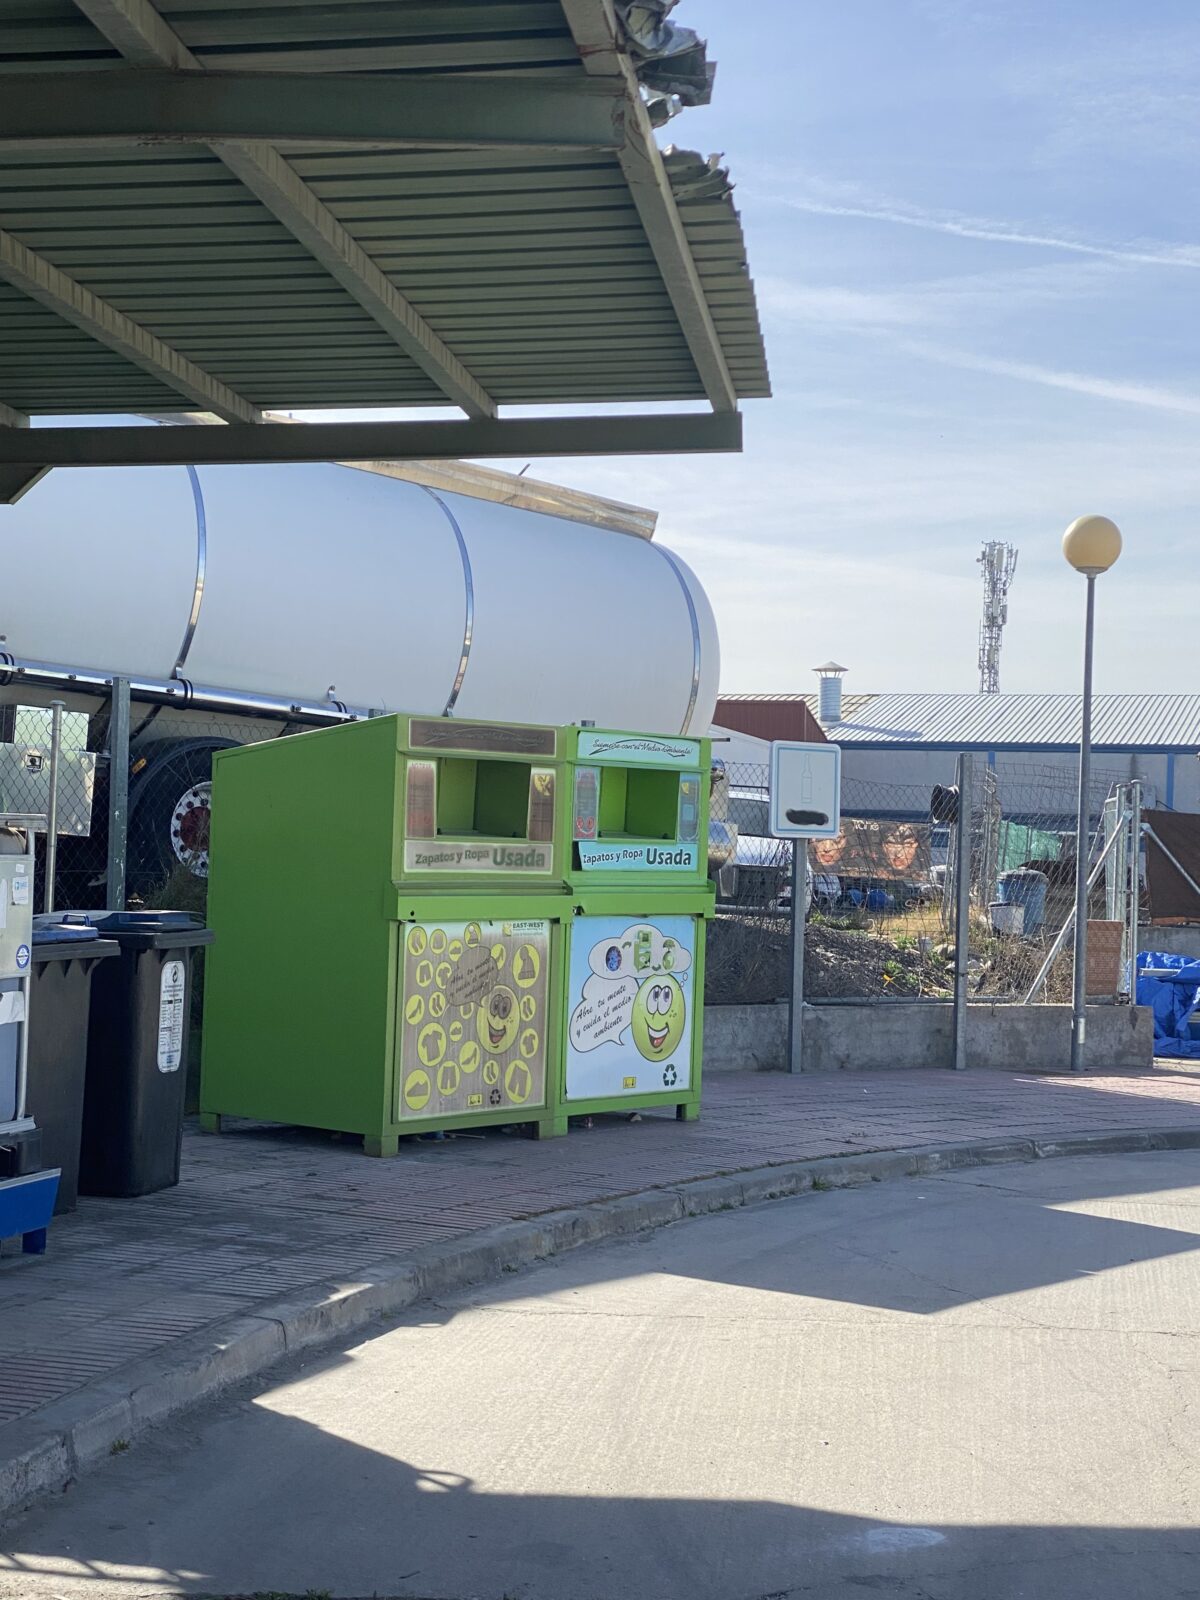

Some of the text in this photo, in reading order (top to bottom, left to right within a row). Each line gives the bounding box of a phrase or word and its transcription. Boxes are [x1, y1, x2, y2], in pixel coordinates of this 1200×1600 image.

[415, 847, 545, 867] Zapatos y Ropa Usada
[583, 847, 692, 865] Zapatos y Ropa Usada
[576, 985, 626, 1023] Abre tu mente
[576, 996, 632, 1039] y cuida el medio
[594, 1015, 623, 1039] ambiente
